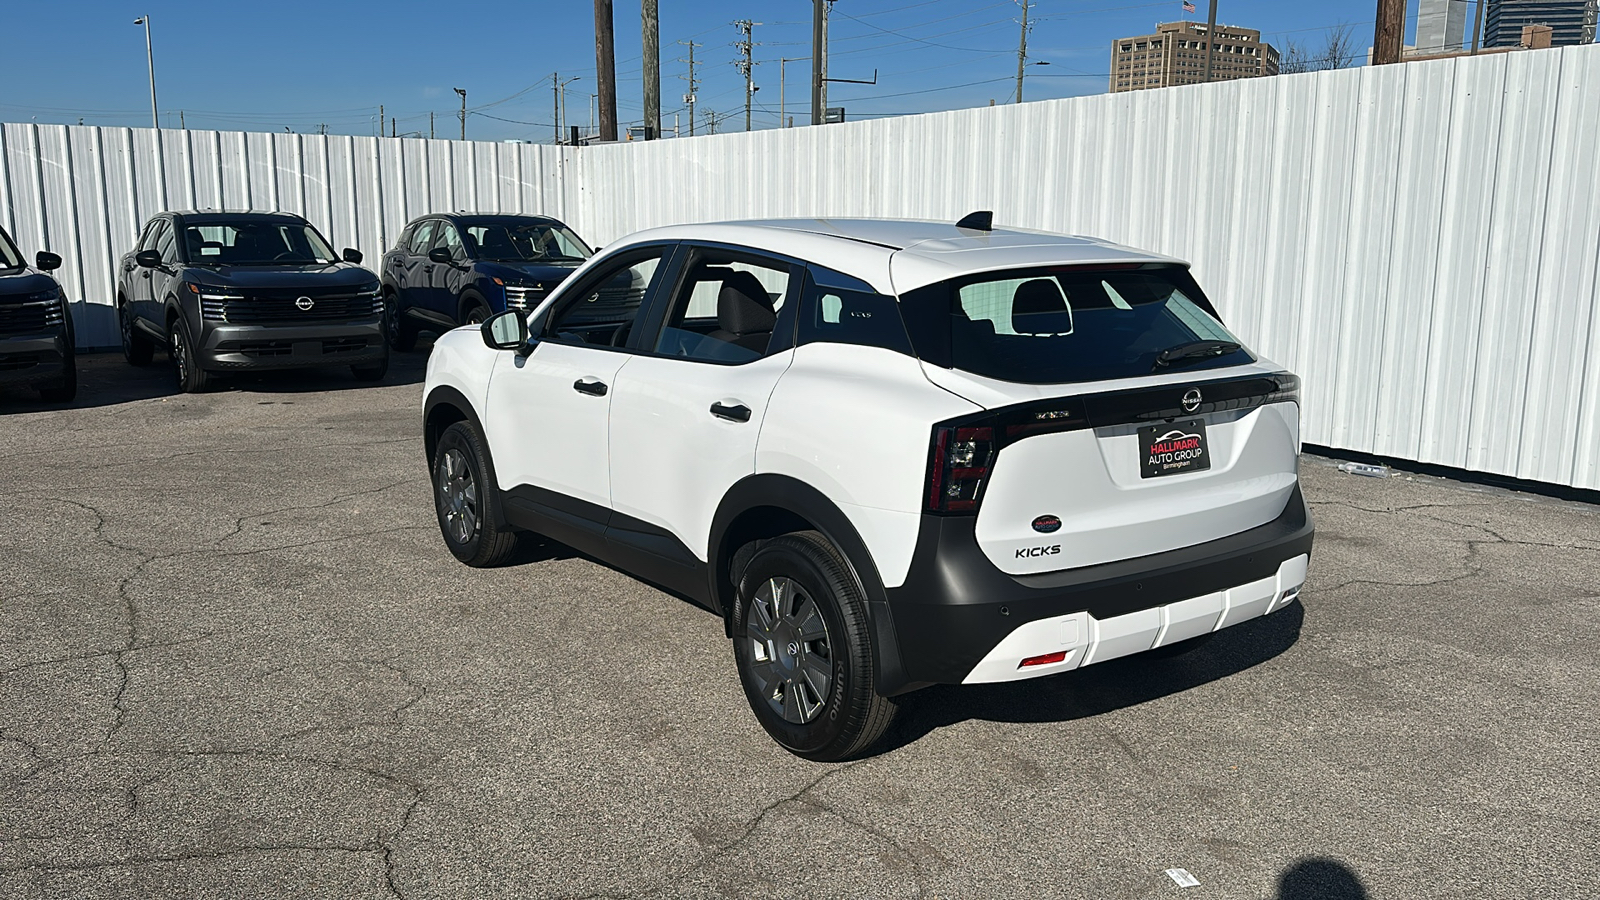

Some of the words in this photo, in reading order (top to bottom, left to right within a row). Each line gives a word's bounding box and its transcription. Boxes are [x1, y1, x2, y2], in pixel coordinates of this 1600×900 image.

[1151, 438, 1199, 454] HALLMARK
[1148, 453, 1173, 465] AUTO
[1174, 448, 1202, 461] GROUP
[1163, 460, 1191, 470] Birmingham
[1015, 544, 1061, 559] KICKS
[830, 661, 844, 721] KUMHO
